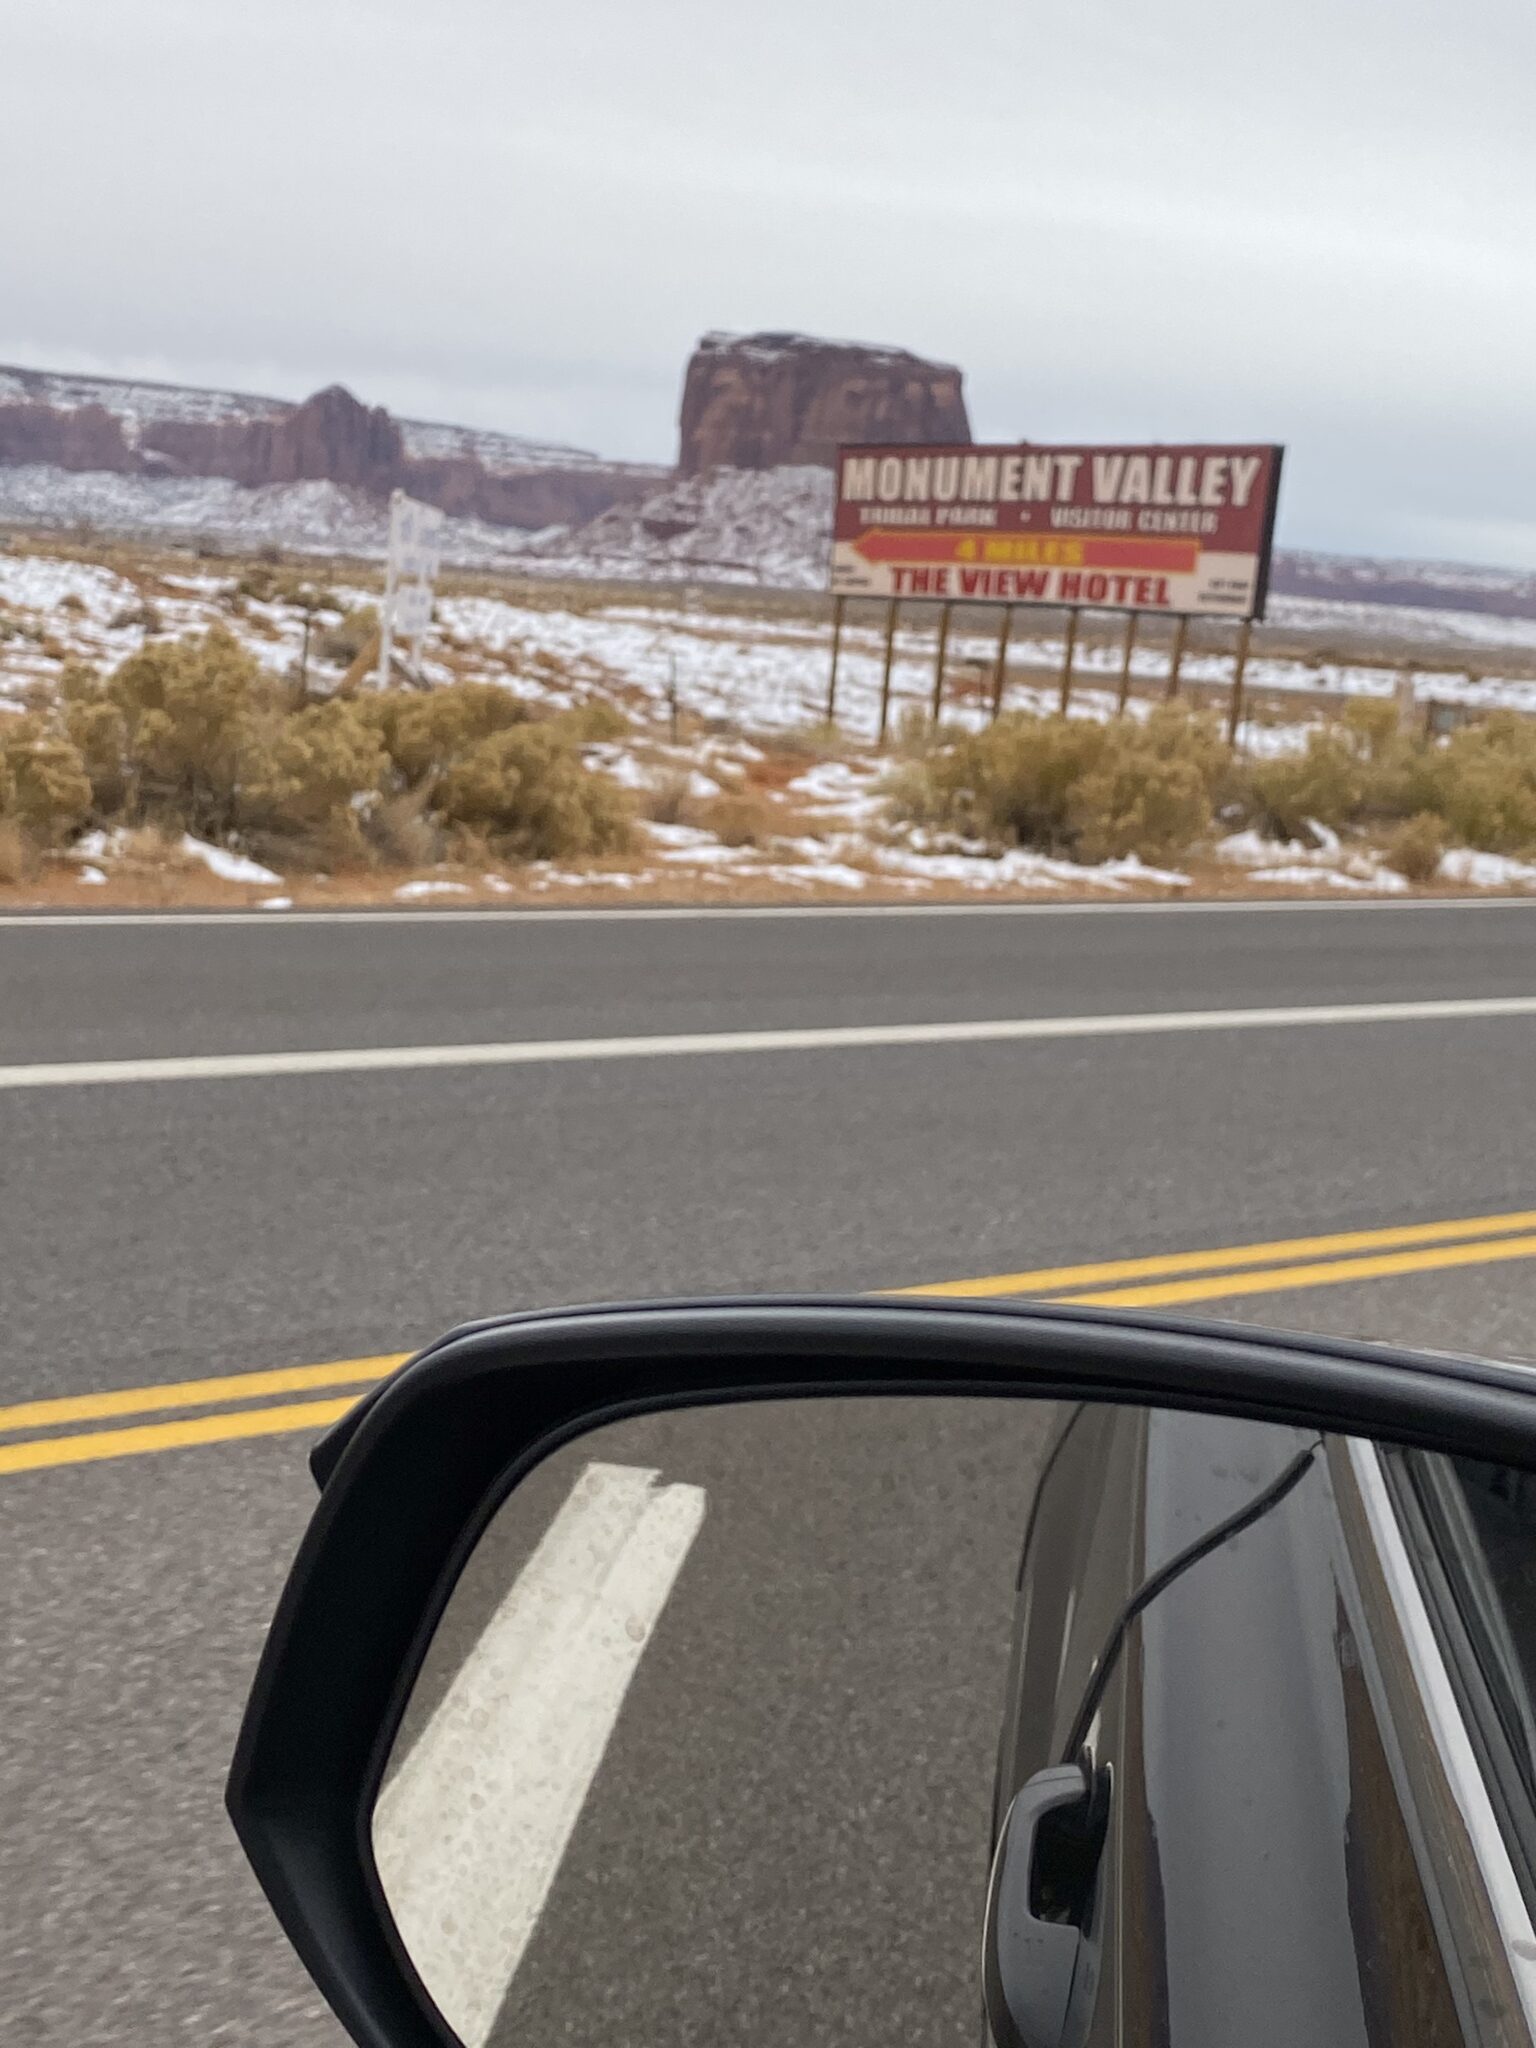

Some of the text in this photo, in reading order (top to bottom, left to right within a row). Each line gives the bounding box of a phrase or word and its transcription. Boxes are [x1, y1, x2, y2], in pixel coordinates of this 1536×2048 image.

[841, 455, 1262, 508] MONUMENT VALLEY
[983, 538, 1083, 566] MILES
[892, 566, 949, 595] THE
[959, 567, 1050, 598] VIEW
[1059, 570, 1170, 608] HOTEL
